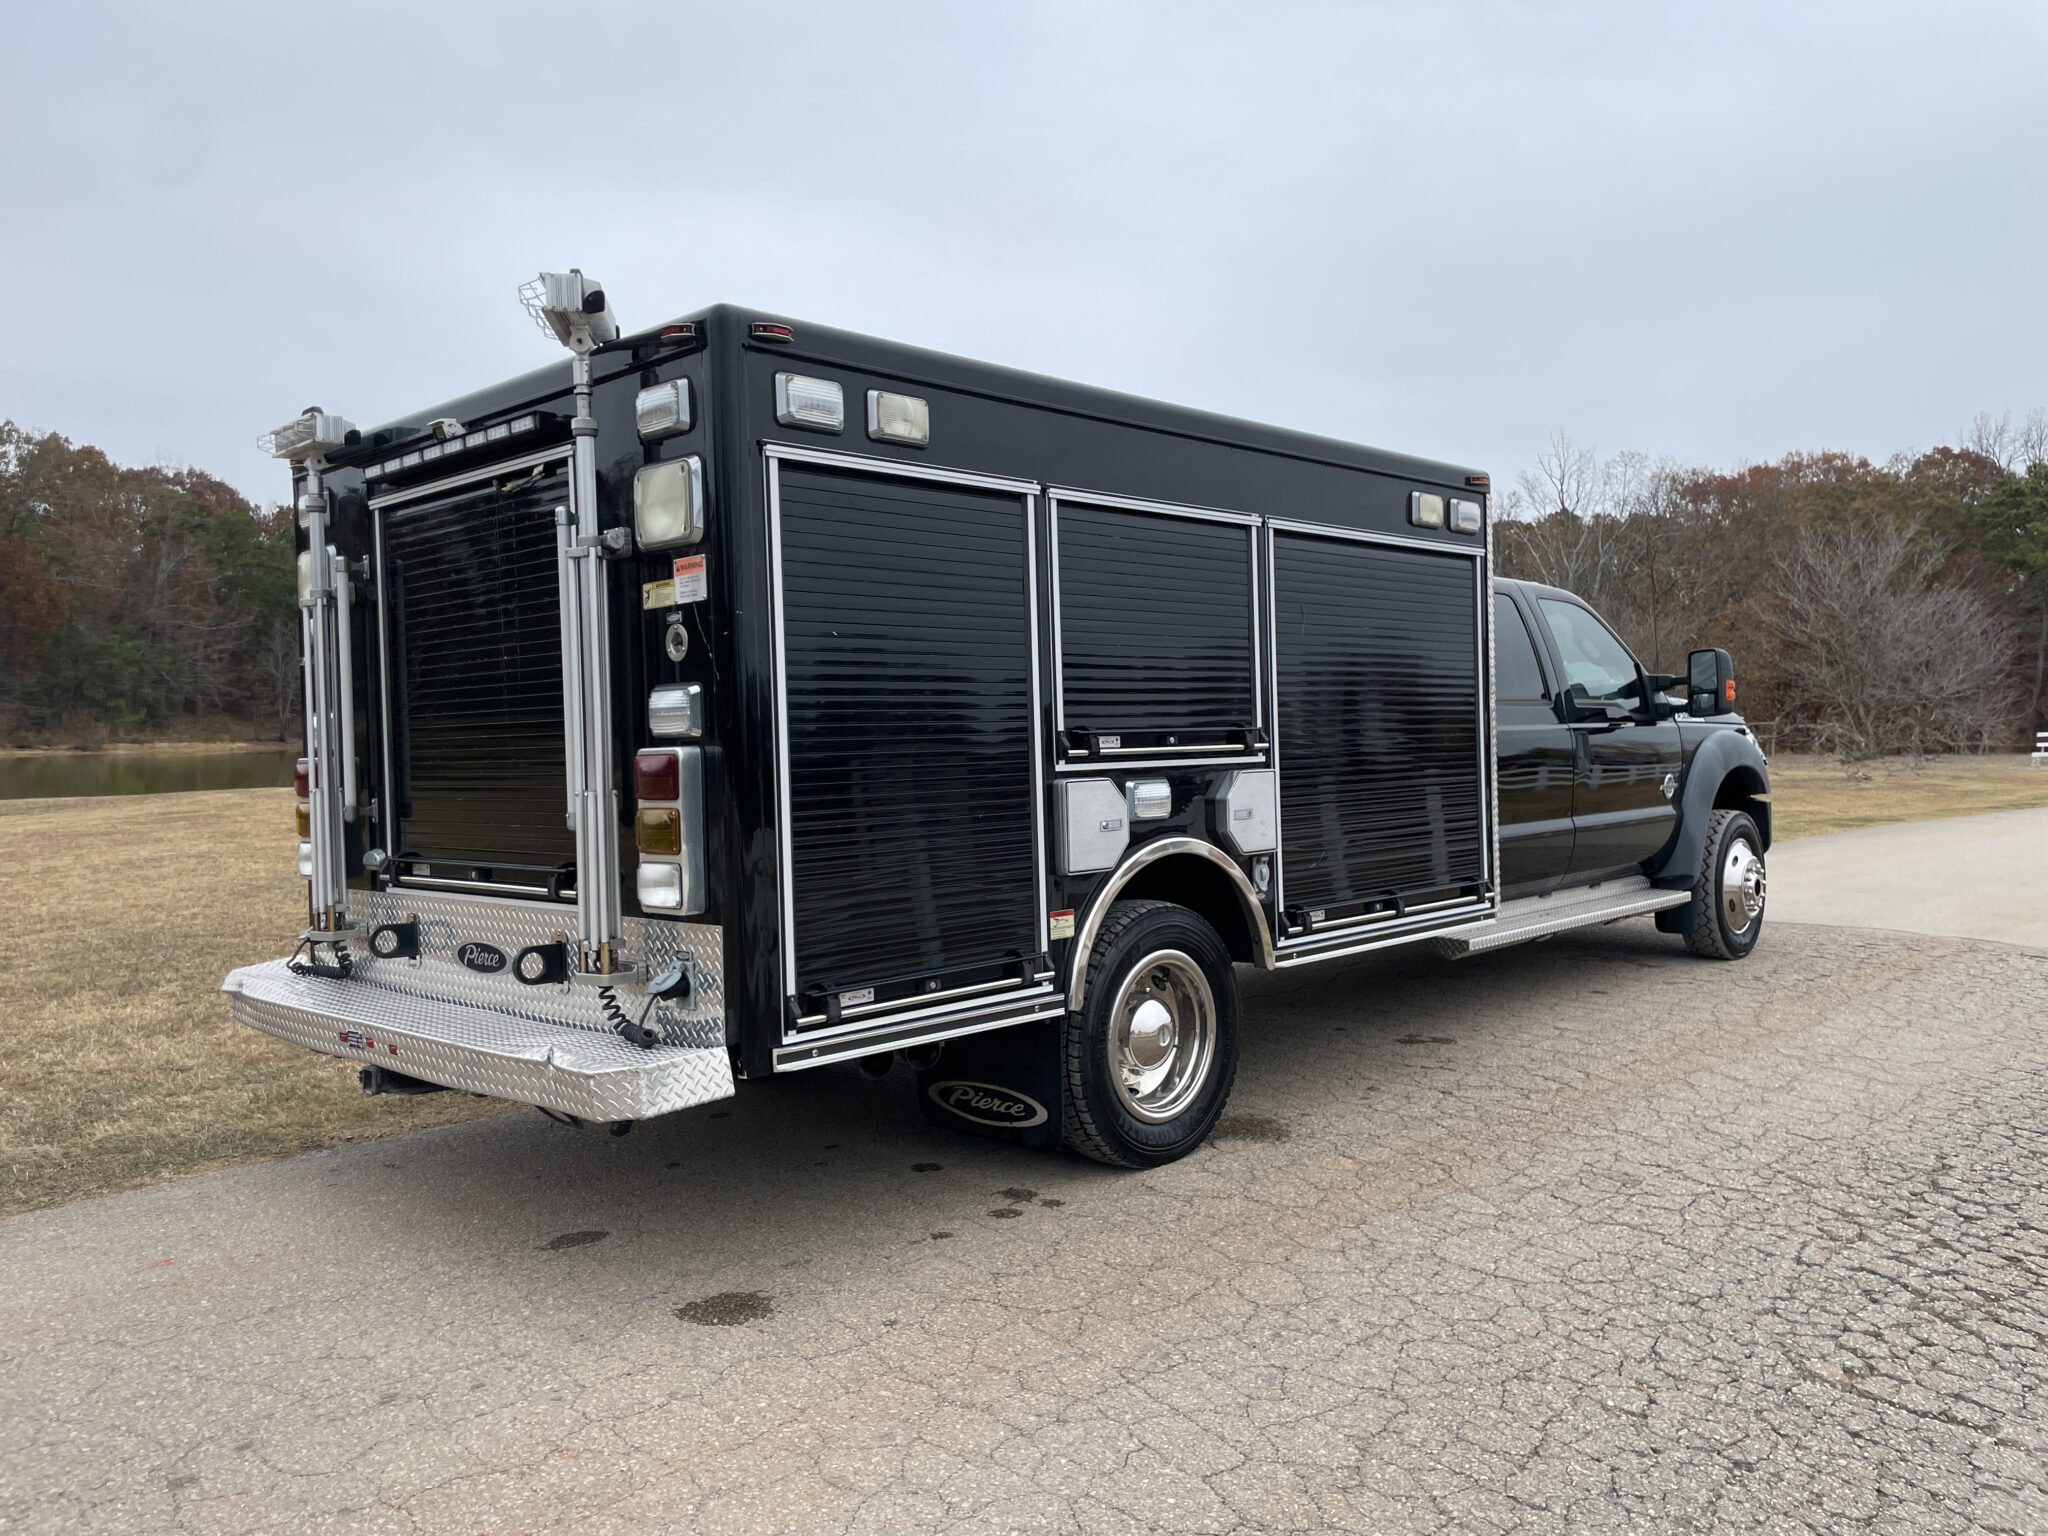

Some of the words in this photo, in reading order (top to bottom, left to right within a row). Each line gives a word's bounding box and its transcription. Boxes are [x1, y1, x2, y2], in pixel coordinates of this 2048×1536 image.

[680, 561, 703, 571] WARNING
[464, 944, 500, 967] Pierce
[949, 1085, 1026, 1116] Pierce
